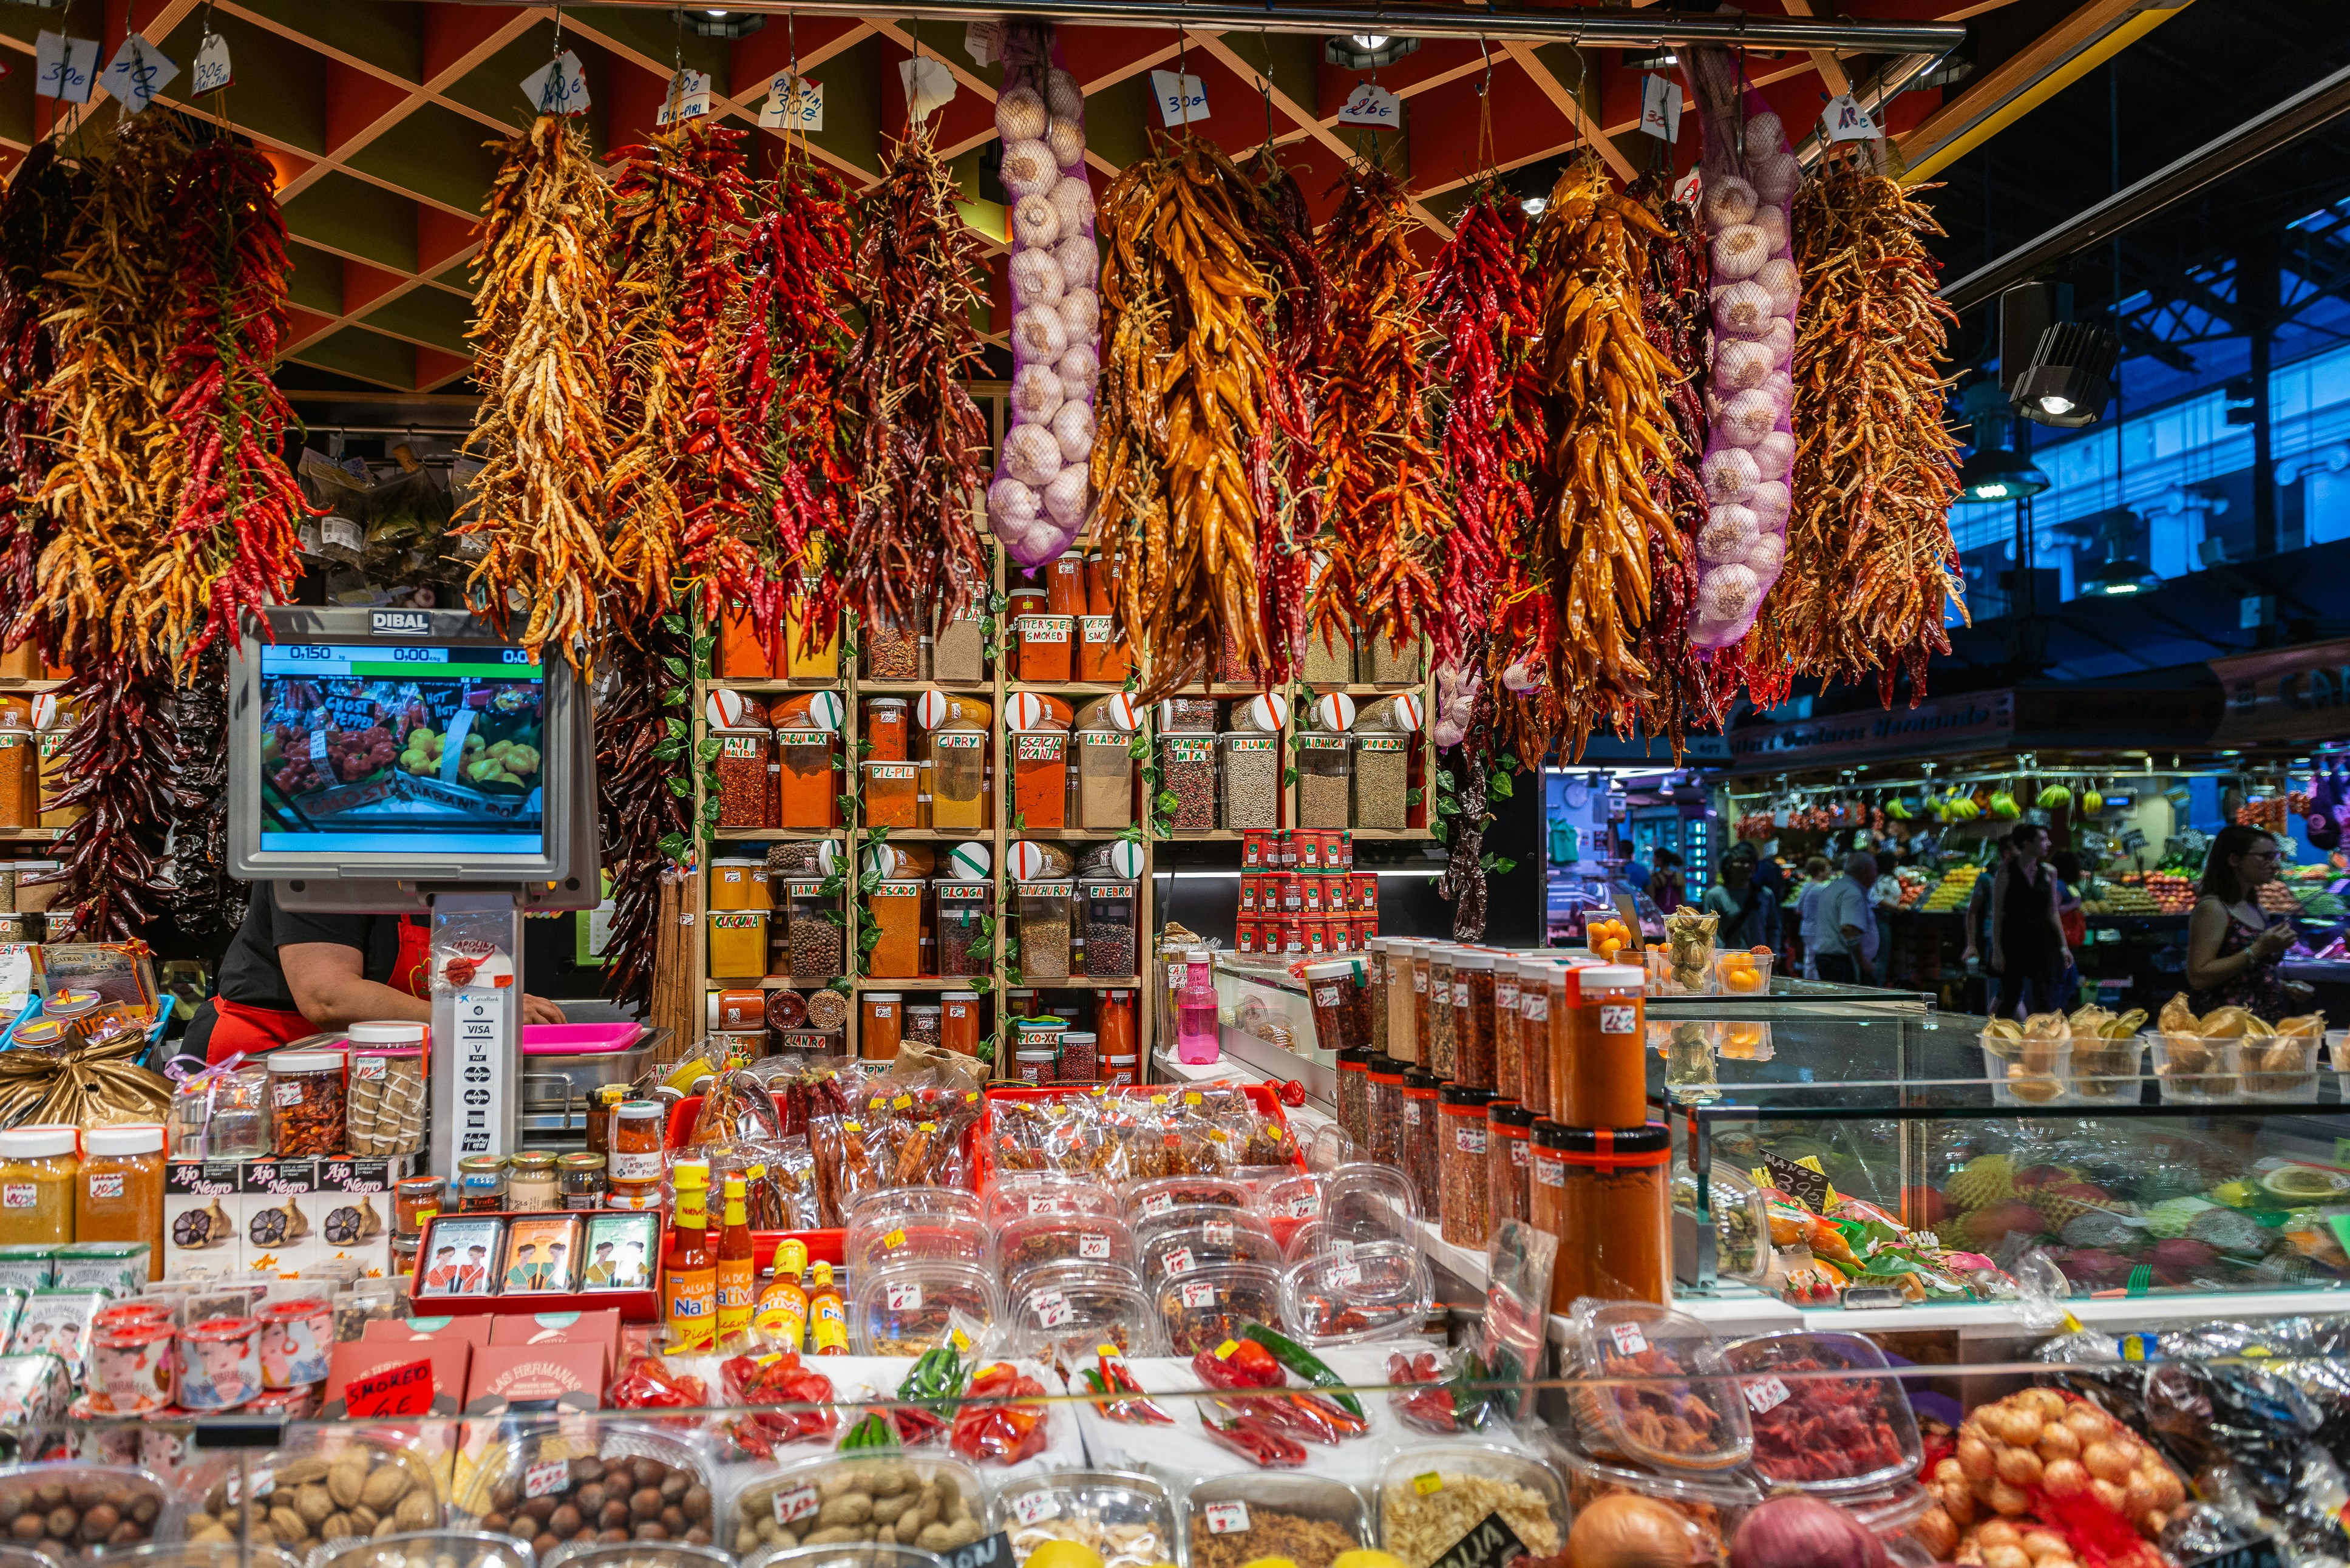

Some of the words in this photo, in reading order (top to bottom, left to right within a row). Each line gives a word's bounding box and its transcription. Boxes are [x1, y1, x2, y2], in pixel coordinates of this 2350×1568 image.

[373, 613, 429, 628] DIBAL
[1026, 631, 1063, 641] SMOKED
[1088, 631, 1125, 641] SMOED
[290, 647, 331, 660] 0,150
[393, 648, 429, 662] 0,00
[503, 650, 529, 664] 0,0
[332, 710, 375, 729] PEPPER
[939, 735, 977, 747] CURRY
[1020, 736, 1061, 748] ESENCIA
[1087, 734, 1127, 745] ASADOS
[1018, 748, 1061, 760] PICANTE
[1177, 750, 1204, 761] MIX
[875, 885, 915, 896] PESCADO
[1092, 886, 1131, 898] ENEBRO
[716, 915, 759, 928] CURCUMA
[467, 1025, 490, 1034] VISA
[785, 1035, 825, 1048] CILANTRO
[248, 1164, 276, 1184] Ajo
[324, 1163, 351, 1184] Ajo
[1764, 1153, 1822, 1182] MANGO
[171, 1166, 199, 1186] Ajo
[191, 1180, 233, 1200] Negro
[267, 1179, 308, 1198] Negro
[342, 1177, 383, 1196] Negro
[681, 1283, 705, 1294] SALSA
[487, 1370, 513, 1394] LAS
[512, 1361, 582, 1393] HERMANAS
[347, 1365, 429, 1407] SMOKED
